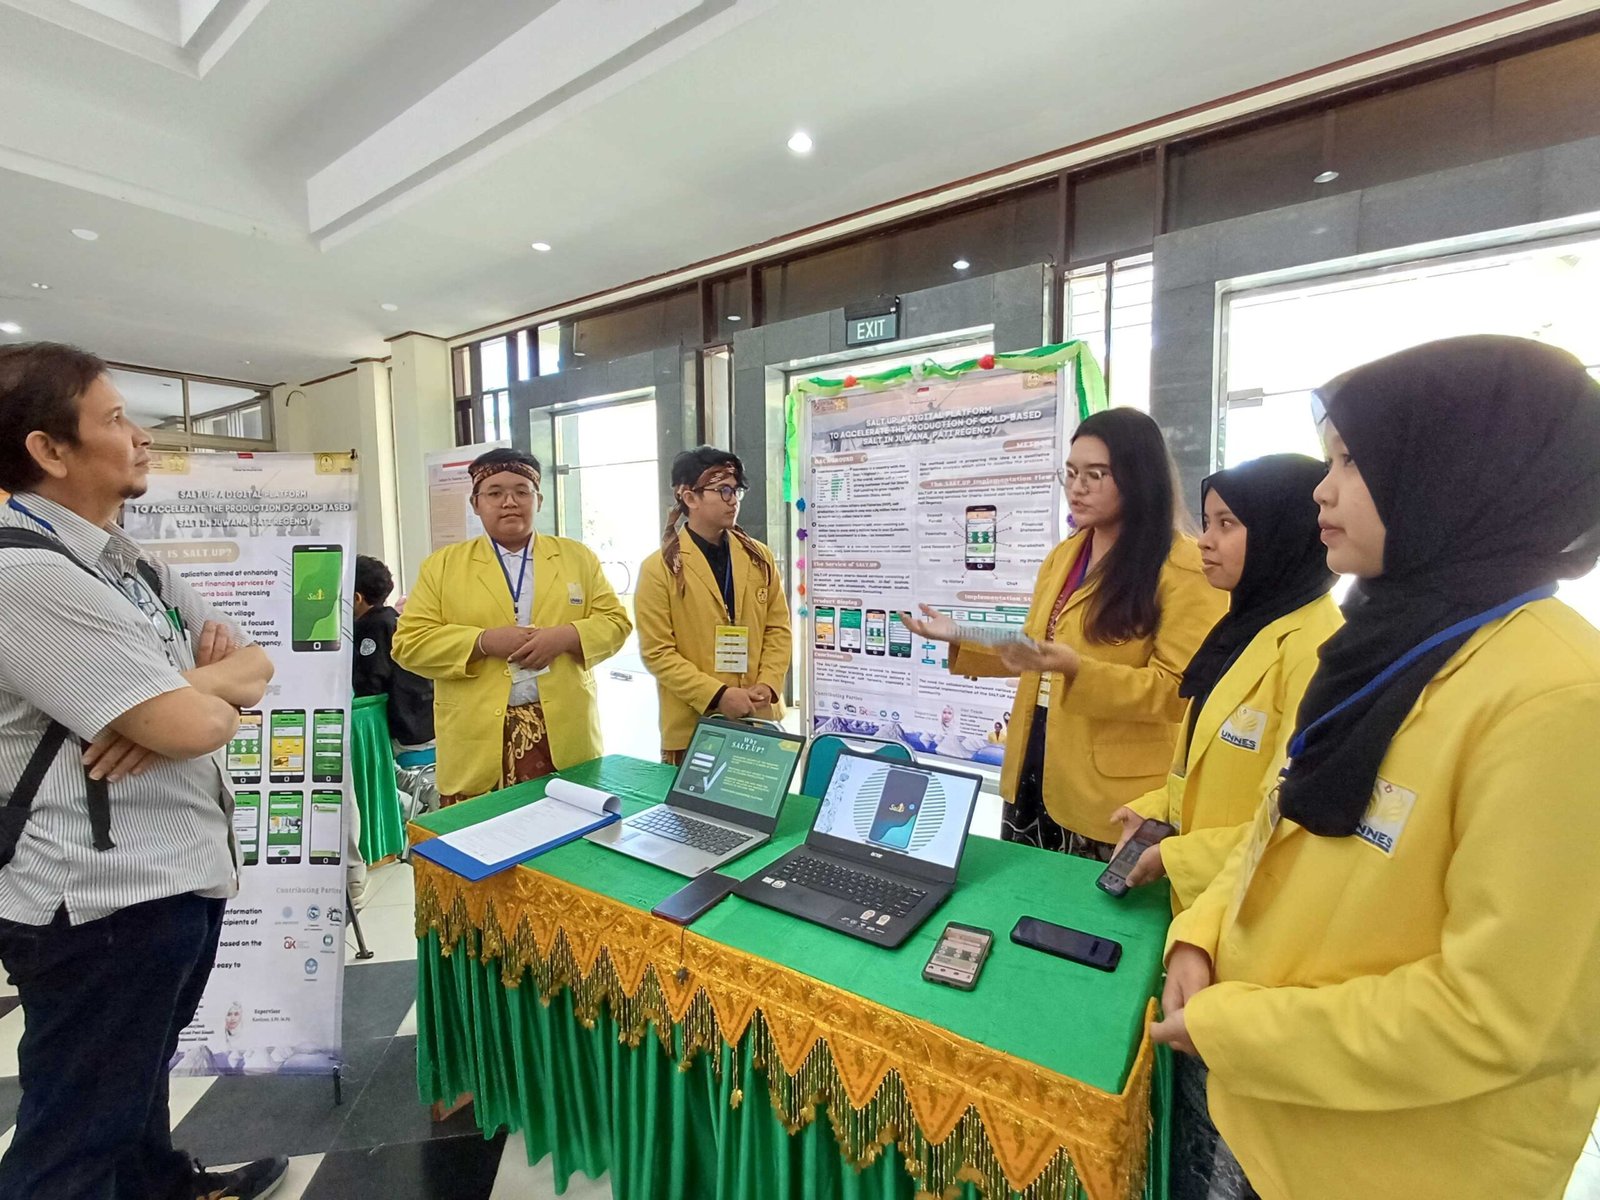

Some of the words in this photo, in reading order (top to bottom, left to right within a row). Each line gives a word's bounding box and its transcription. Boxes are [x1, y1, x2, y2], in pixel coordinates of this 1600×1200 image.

[857, 319, 886, 340] EXIT
[908, 412, 944, 422] DIGITAL
[945, 406, 993, 418] PLATFORM
[829, 432, 839, 440] TO
[839, 427, 889, 439] ACCELERATE
[890, 425, 906, 433] THE
[907, 418, 964, 431] PRODUCTION
[966, 417, 979, 426] OF
[979, 410, 1042, 424] GOLD-BASED
[862, 437, 883, 446] SALT
[883, 436, 894, 444] IN
[932, 430, 955, 440] PATI
[954, 425, 998, 437] REGENCY
[225, 490, 262, 499] DIGITAL
[264, 490, 308, 499] PLATFORM
[133, 505, 149, 513] TO
[151, 505, 207, 513] ACCELERATE
[208, 505, 224, 513] THE
[225, 504, 281, 513] PRODUCTION
[283, 504, 294, 512] OF
[296, 503, 351, 512] GOLD-BASED
[177, 519, 196, 528] SALT
[200, 519, 210, 528] IN
[250, 518, 272, 528] PATI
[274, 517, 312, 527] REGENCY
[168, 549, 178, 558] IS
[214, 569, 234, 577] aimed
[243, 569, 278, 578] enhancing
[205, 580, 235, 588] financing
[964, 594, 1022, 602] Implementation
[234, 610, 255, 618] village
[248, 619, 274, 627] focused
[1221, 730, 1257, 748] UNNES
[276, 886, 319, 895] Contributing
[234, 961, 241, 969] to
